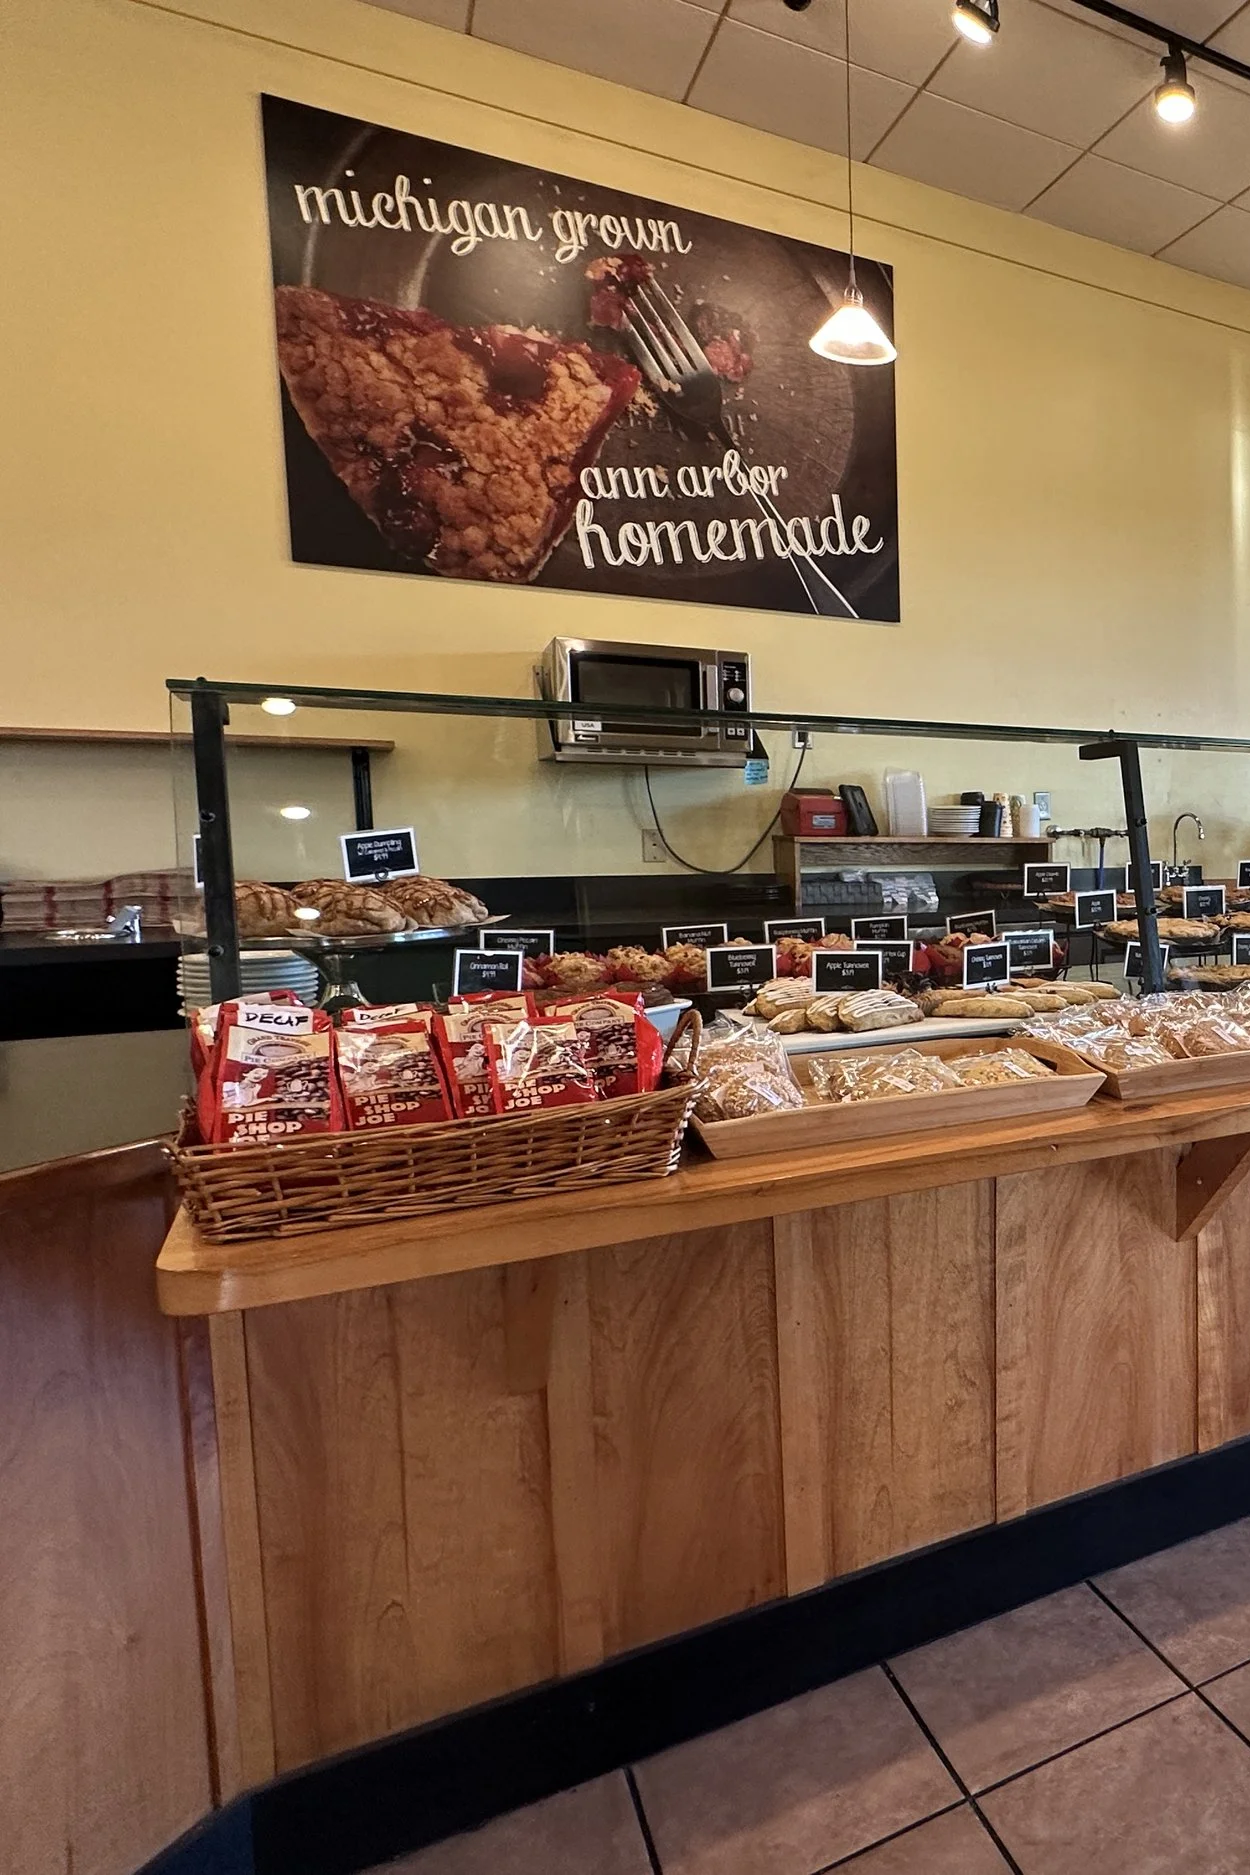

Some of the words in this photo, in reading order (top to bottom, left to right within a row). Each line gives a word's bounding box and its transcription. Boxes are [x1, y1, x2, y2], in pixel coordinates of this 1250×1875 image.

[294, 169, 542, 256] michigan
[552, 206, 692, 264] grown
[580, 465, 668, 499] ann
[677, 448, 788, 497] arbor
[575, 493, 884, 569] homemade
[825, 962, 842, 970] Apple
[245, 1012, 309, 1027] DECAF
[512, 1083, 566, 1098] SHOP
[354, 1093, 389, 1107] PIE
[505, 1095, 542, 1110] JOE
[363, 1100, 420, 1116] SHOP
[228, 1110, 268, 1124] PIE
[355, 1112, 396, 1127] JOE
[235, 1120, 302, 1136] SHOP
